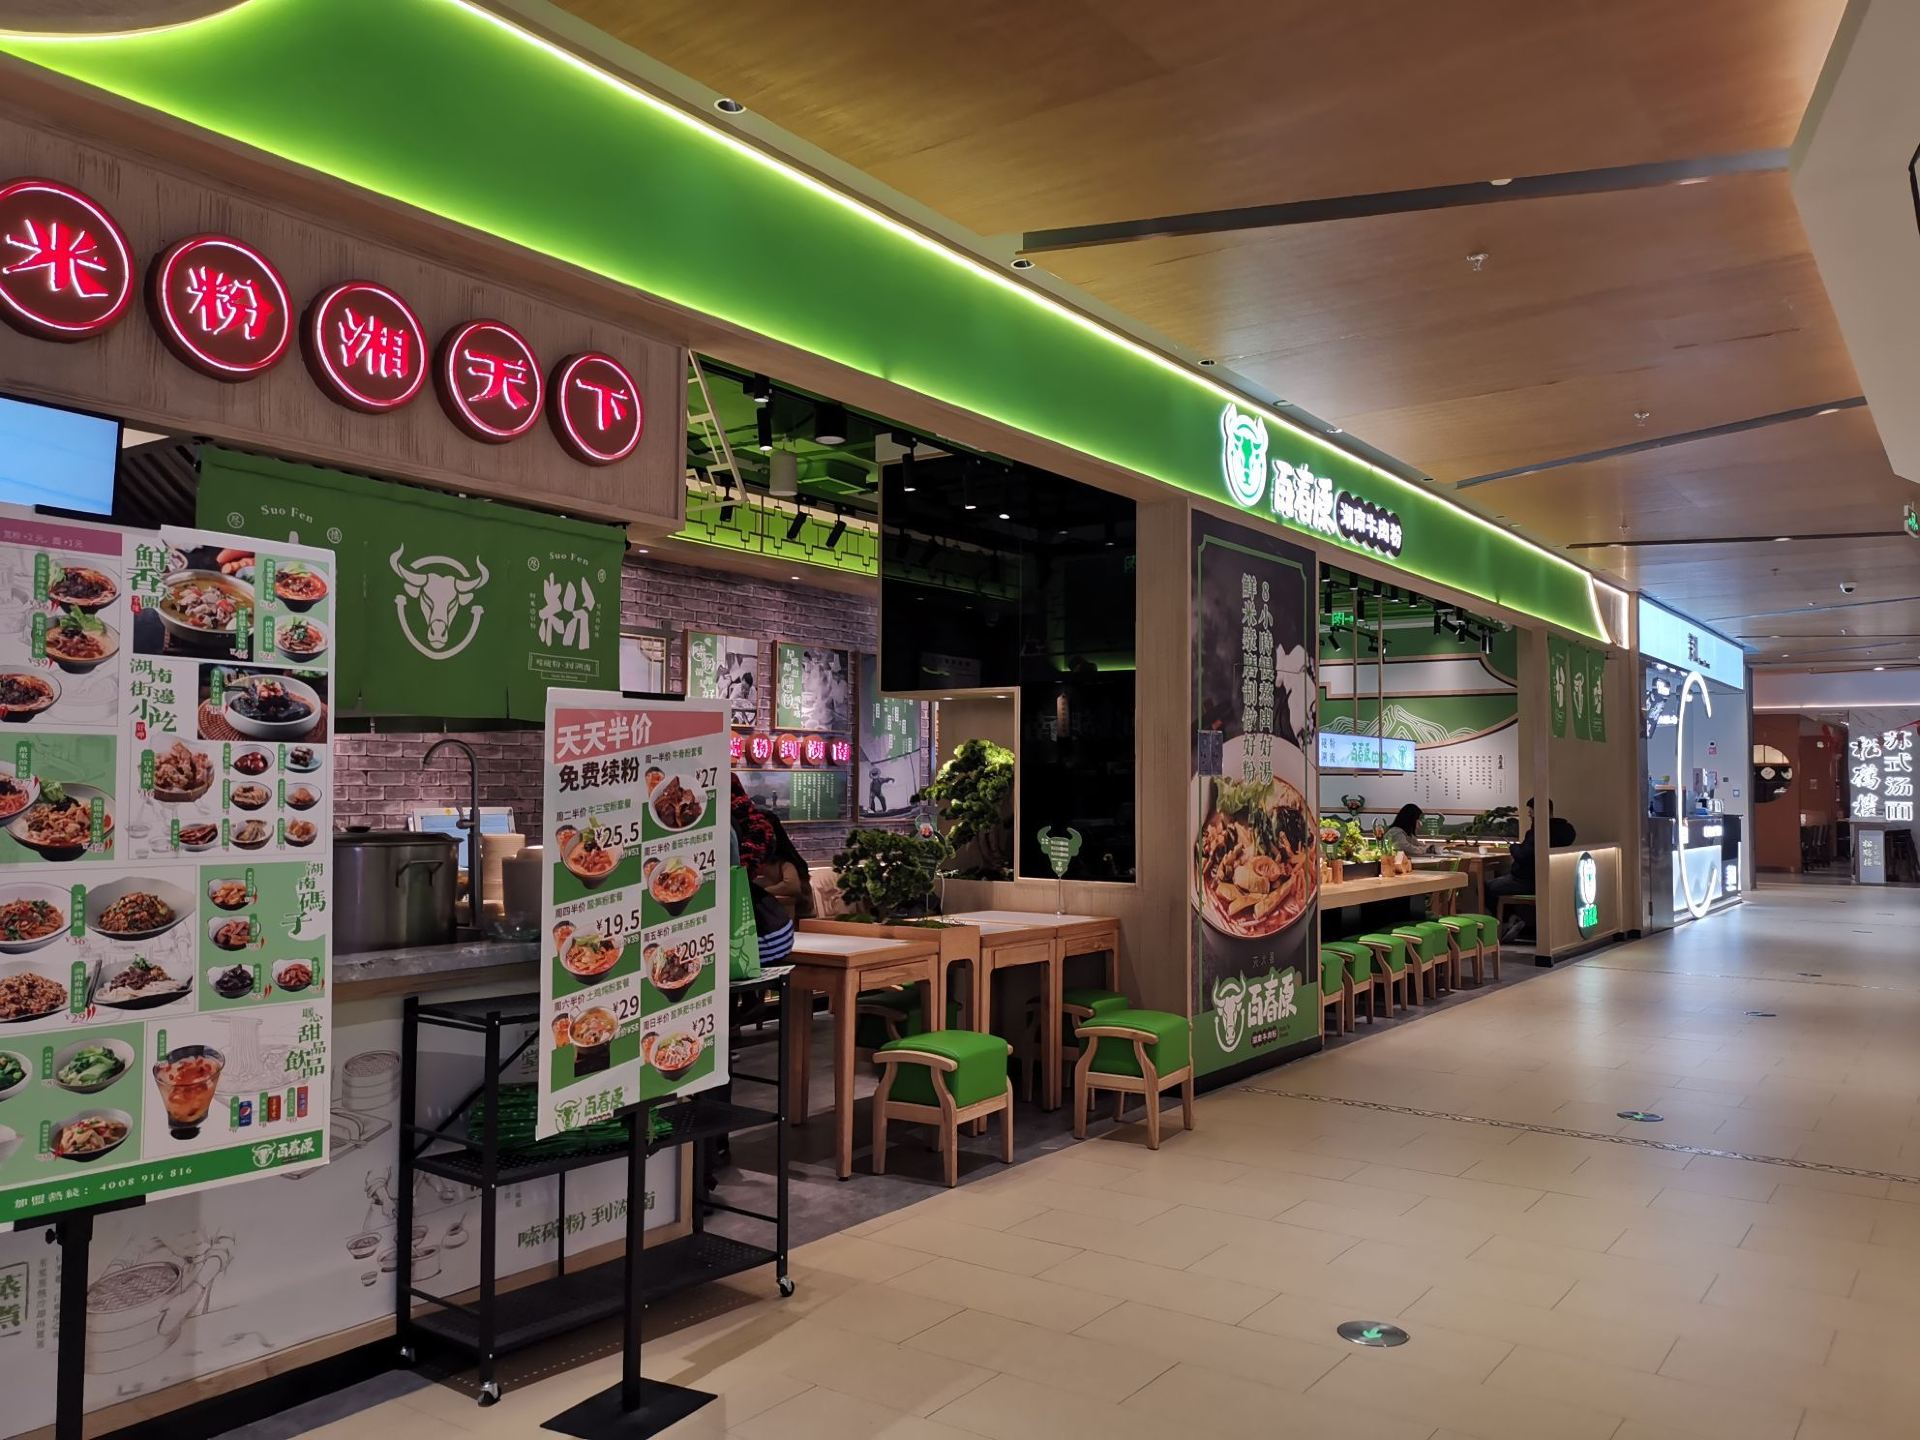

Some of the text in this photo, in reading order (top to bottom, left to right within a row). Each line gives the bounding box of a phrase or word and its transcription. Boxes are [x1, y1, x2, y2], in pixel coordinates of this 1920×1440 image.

[3, 218, 629, 431] 米粉湘天下
[260, 505, 313, 524] Suo Fen
[549, 552, 589, 566] Suo Fen
[539, 572, 595, 650] 粉
[556, 712, 652, 759] 天天半价
[559, 756, 640, 793] 免费续粉
[695, 766, 718, 788] ¥27
[1883, 731, 1914, 821] 苏式汤面
[595, 821, 640, 849] ¥25.5
[693, 848, 716, 871] ¥24
[596, 908, 641, 938] ¥19.5
[676, 932, 715, 961] ¥20.95
[612, 995, 640, 1020] ¥29
[692, 1013, 715, 1037] ¥23
[100, 1177, 135, 1191] 4008
[141, 1171, 164, 1182] 916
[170, 1167, 193, 1178] 816
